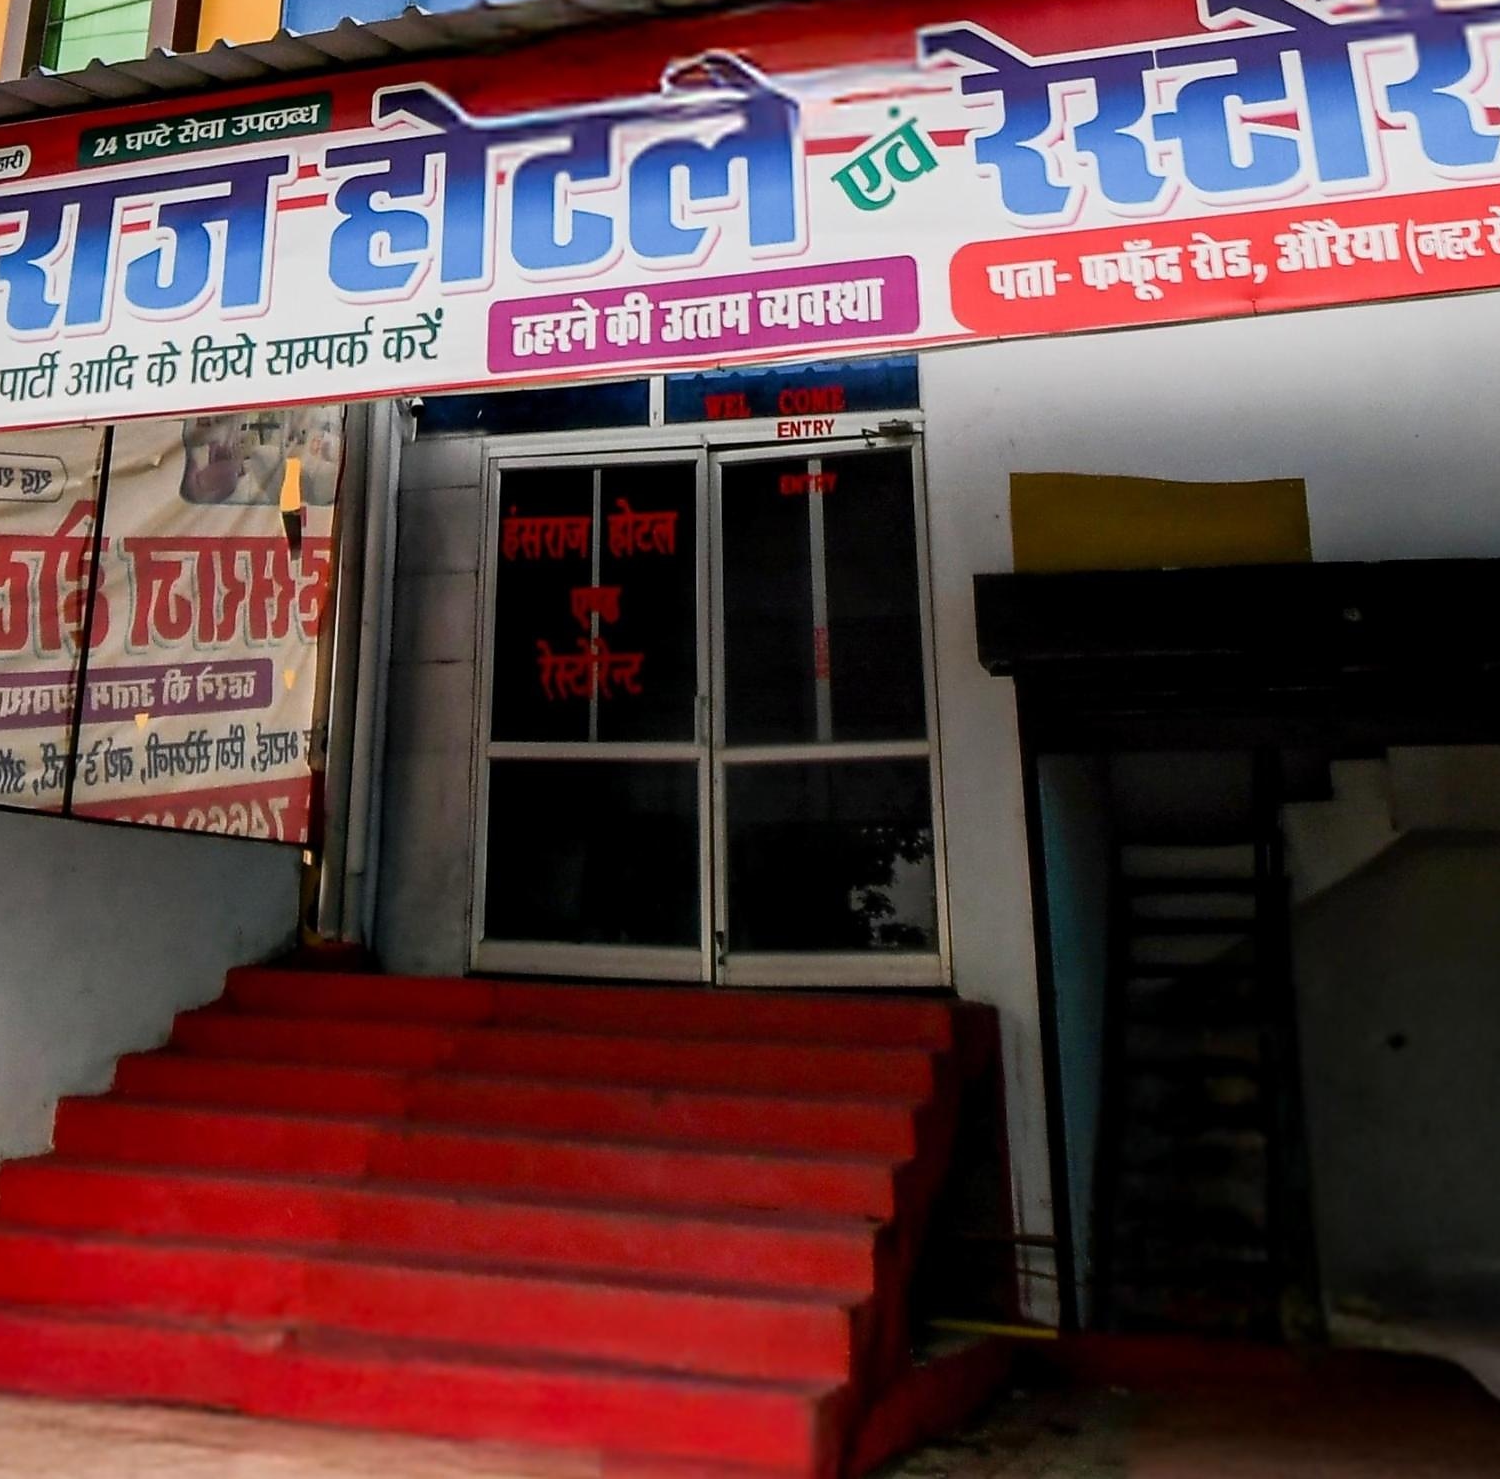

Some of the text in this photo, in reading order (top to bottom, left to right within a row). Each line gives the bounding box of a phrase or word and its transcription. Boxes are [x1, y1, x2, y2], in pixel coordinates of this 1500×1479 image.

[93, 103, 321, 159] 24 घण्टे सेवा उपलब्ध
[831, 105, 939, 212] एवं
[1187, 232, 1269, 285] रोड,
[1405, 218, 1485, 274] (नहर
[510, 277, 886, 358] ठहरने की उत्तम व्यवस्था
[0, 350, 61, 404] पार्टी
[64, 344, 136, 397] आदि
[146, 339, 185, 388] के
[190, 332, 257, 385] लिये
[265, 316, 375, 377] सम्पर्क
[382, 307, 444, 364] करें
[704, 385, 846, 418] WEL COME
[777, 419, 835, 438] ENTRY
[502, 497, 678, 561] हंसराज होटल
